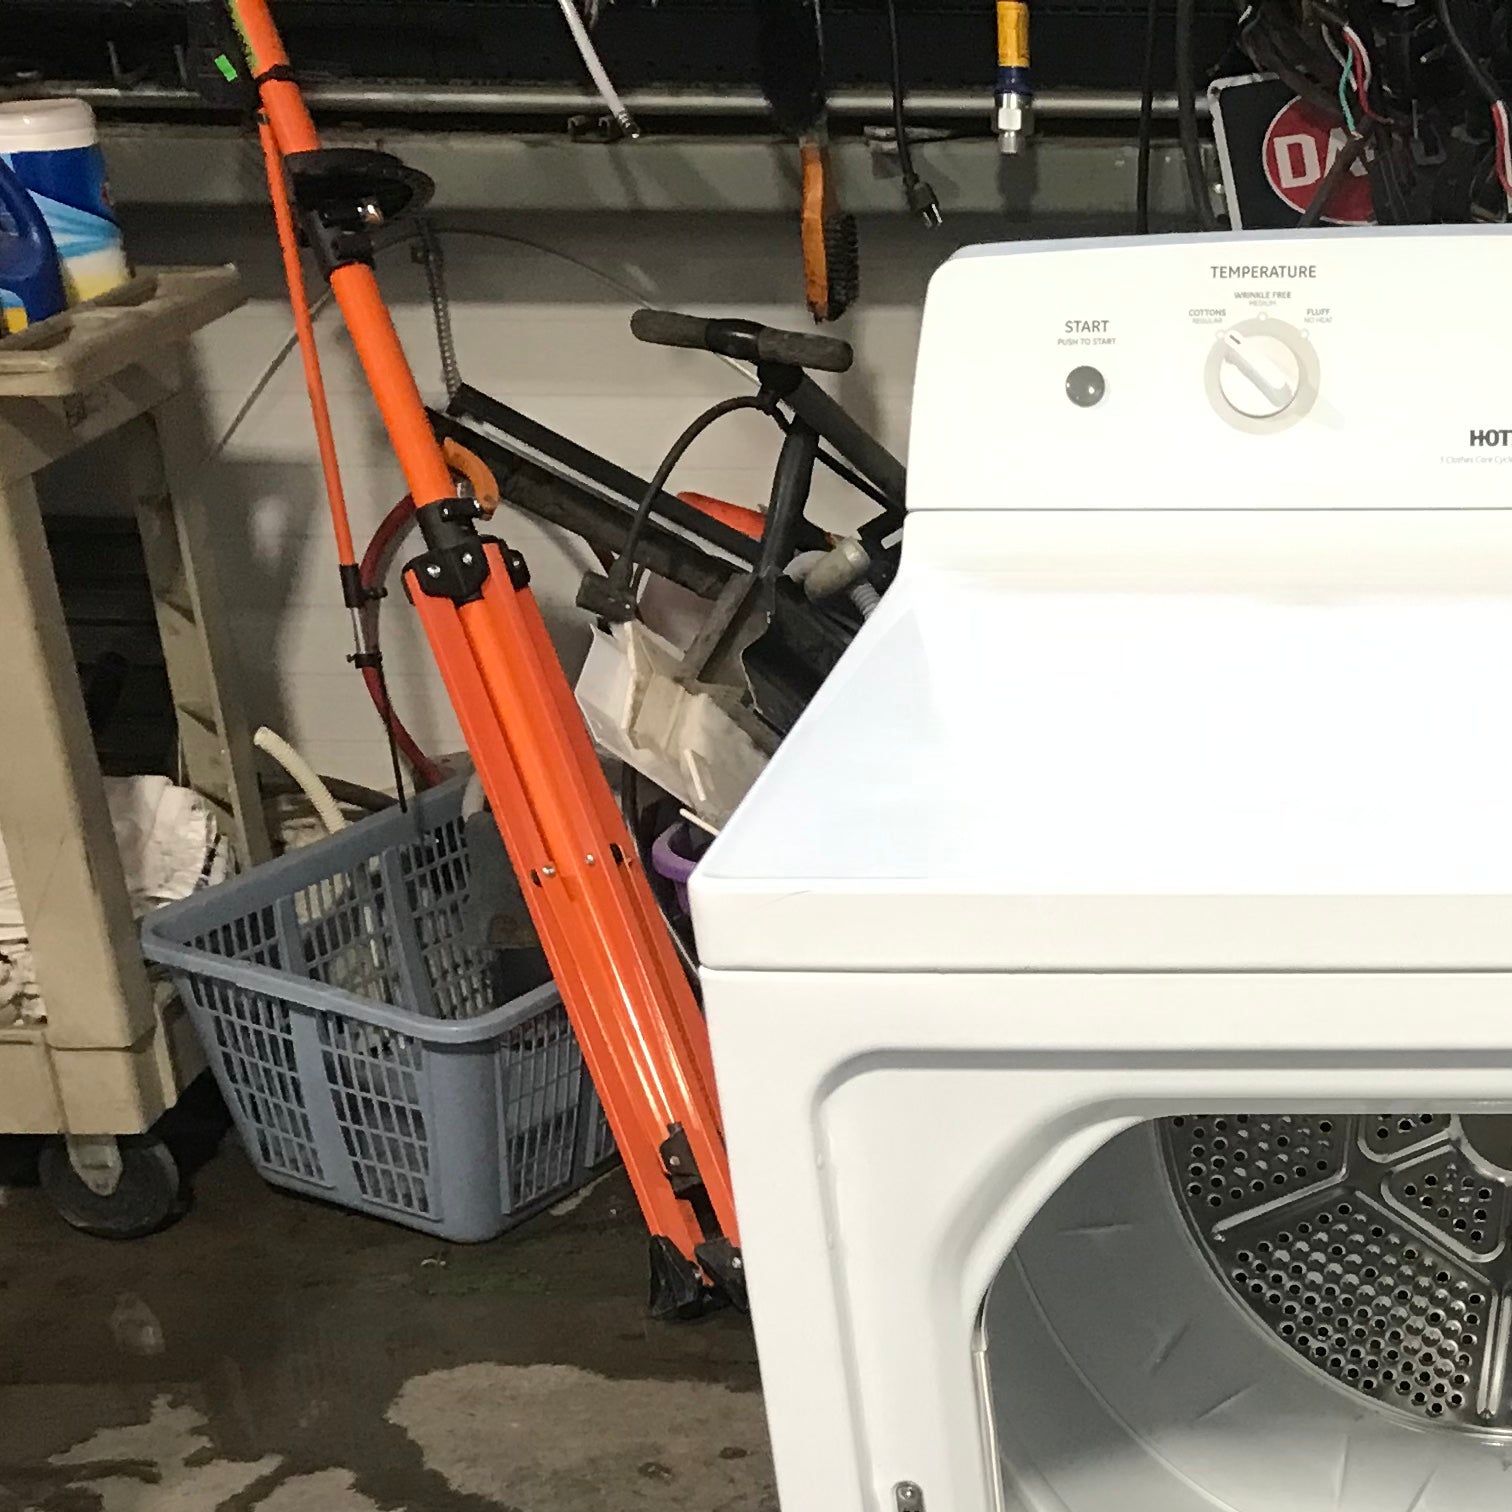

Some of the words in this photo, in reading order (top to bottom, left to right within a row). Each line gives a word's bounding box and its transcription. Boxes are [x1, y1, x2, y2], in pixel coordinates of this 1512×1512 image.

[1211, 265, 1316, 278] TEMPERATURE
[1234, 291, 1271, 300] WRINKLE
[1272, 290, 1292, 300] FREE
[1189, 308, 1227, 317] COTTONS
[1307, 307, 1331, 317] FLUFF
[1065, 320, 1109, 333] START
[1057, 337, 1079, 346] PUSH
[1080, 337, 1092, 346] TO
[1093, 337, 1117, 346] START
[1475, 455, 1494, 464] Care
